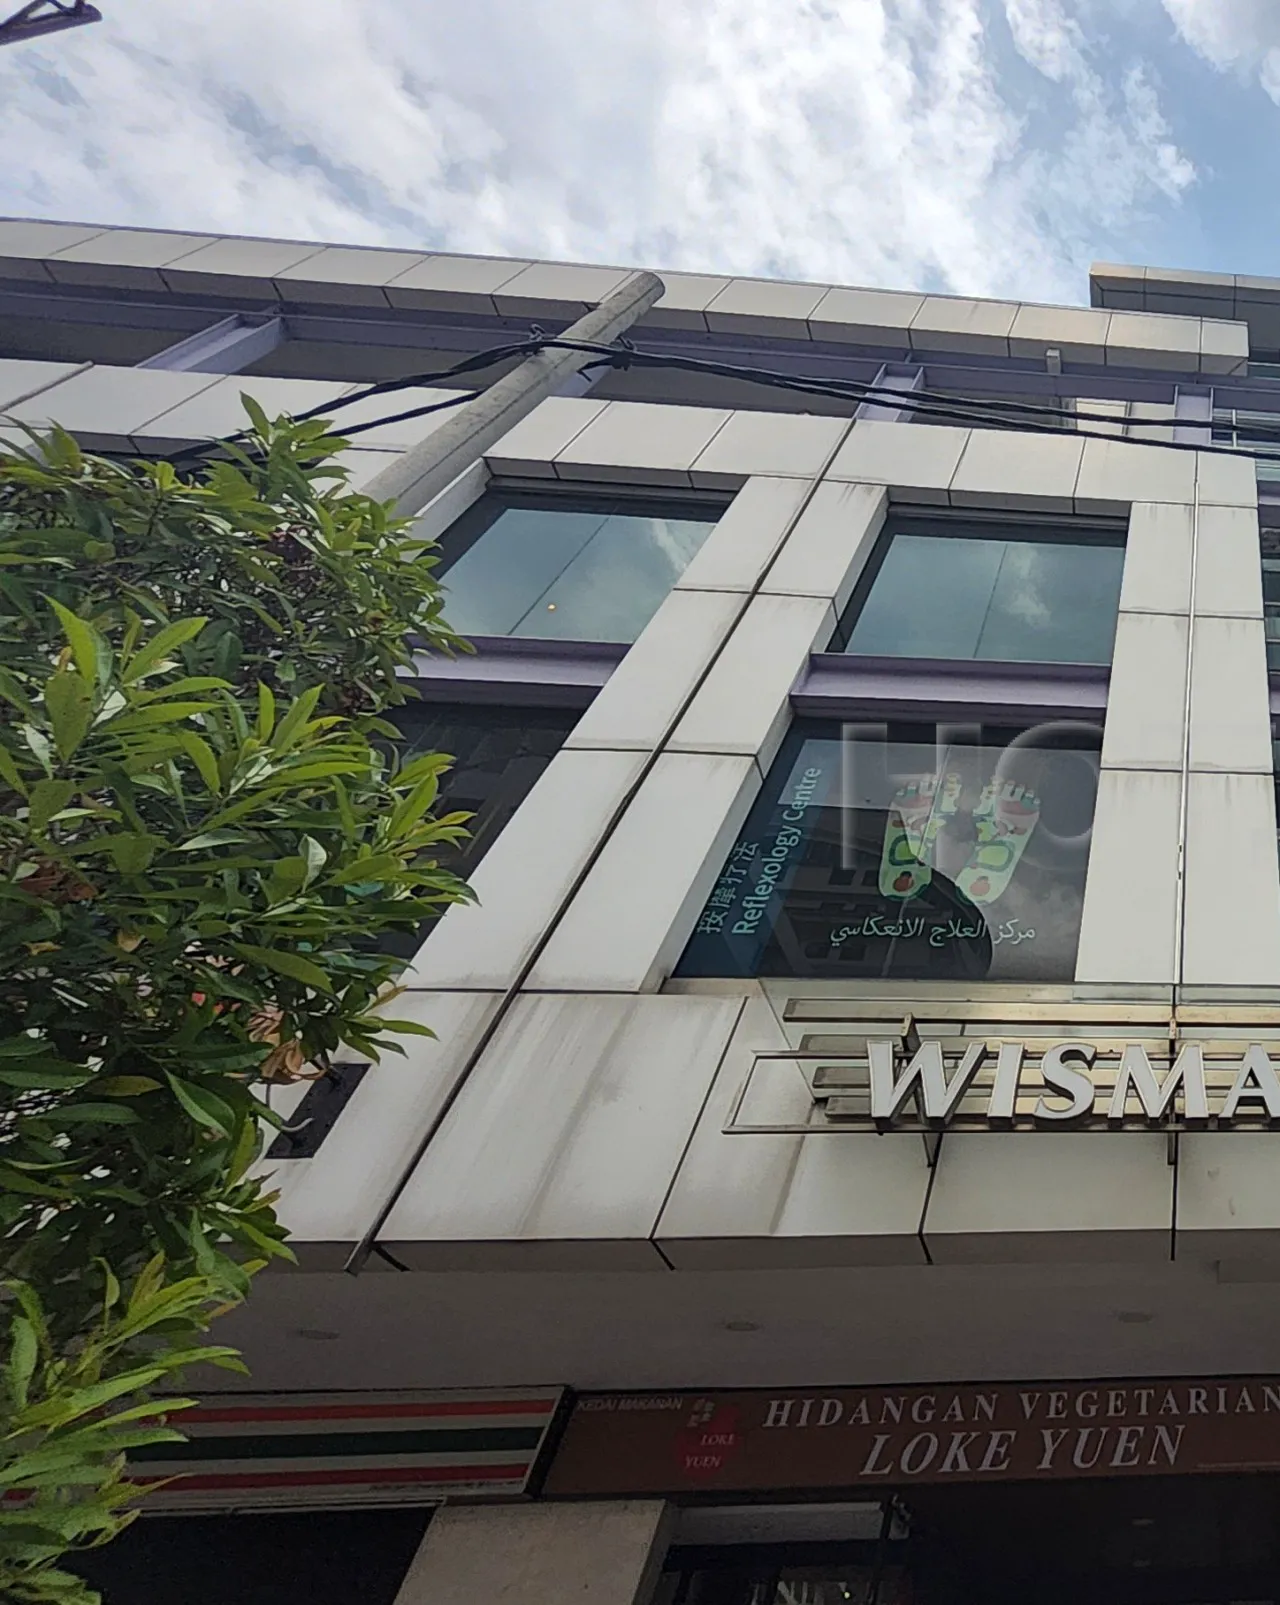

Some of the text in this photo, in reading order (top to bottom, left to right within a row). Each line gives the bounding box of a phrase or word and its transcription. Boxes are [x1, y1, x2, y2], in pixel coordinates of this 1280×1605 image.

[732, 767, 822, 936] Reflexology Centre
[830, 915, 1036, 948] مركز العلاج الانعكاسي
[577, 1397, 616, 1412] KEDAI
[761, 1392, 1000, 1428] HIDANGAN
[700, 1433, 736, 1447] LOKE
[859, 1423, 1188, 1477] LOKE YUEN
[684, 1455, 722, 1469] YUEN
